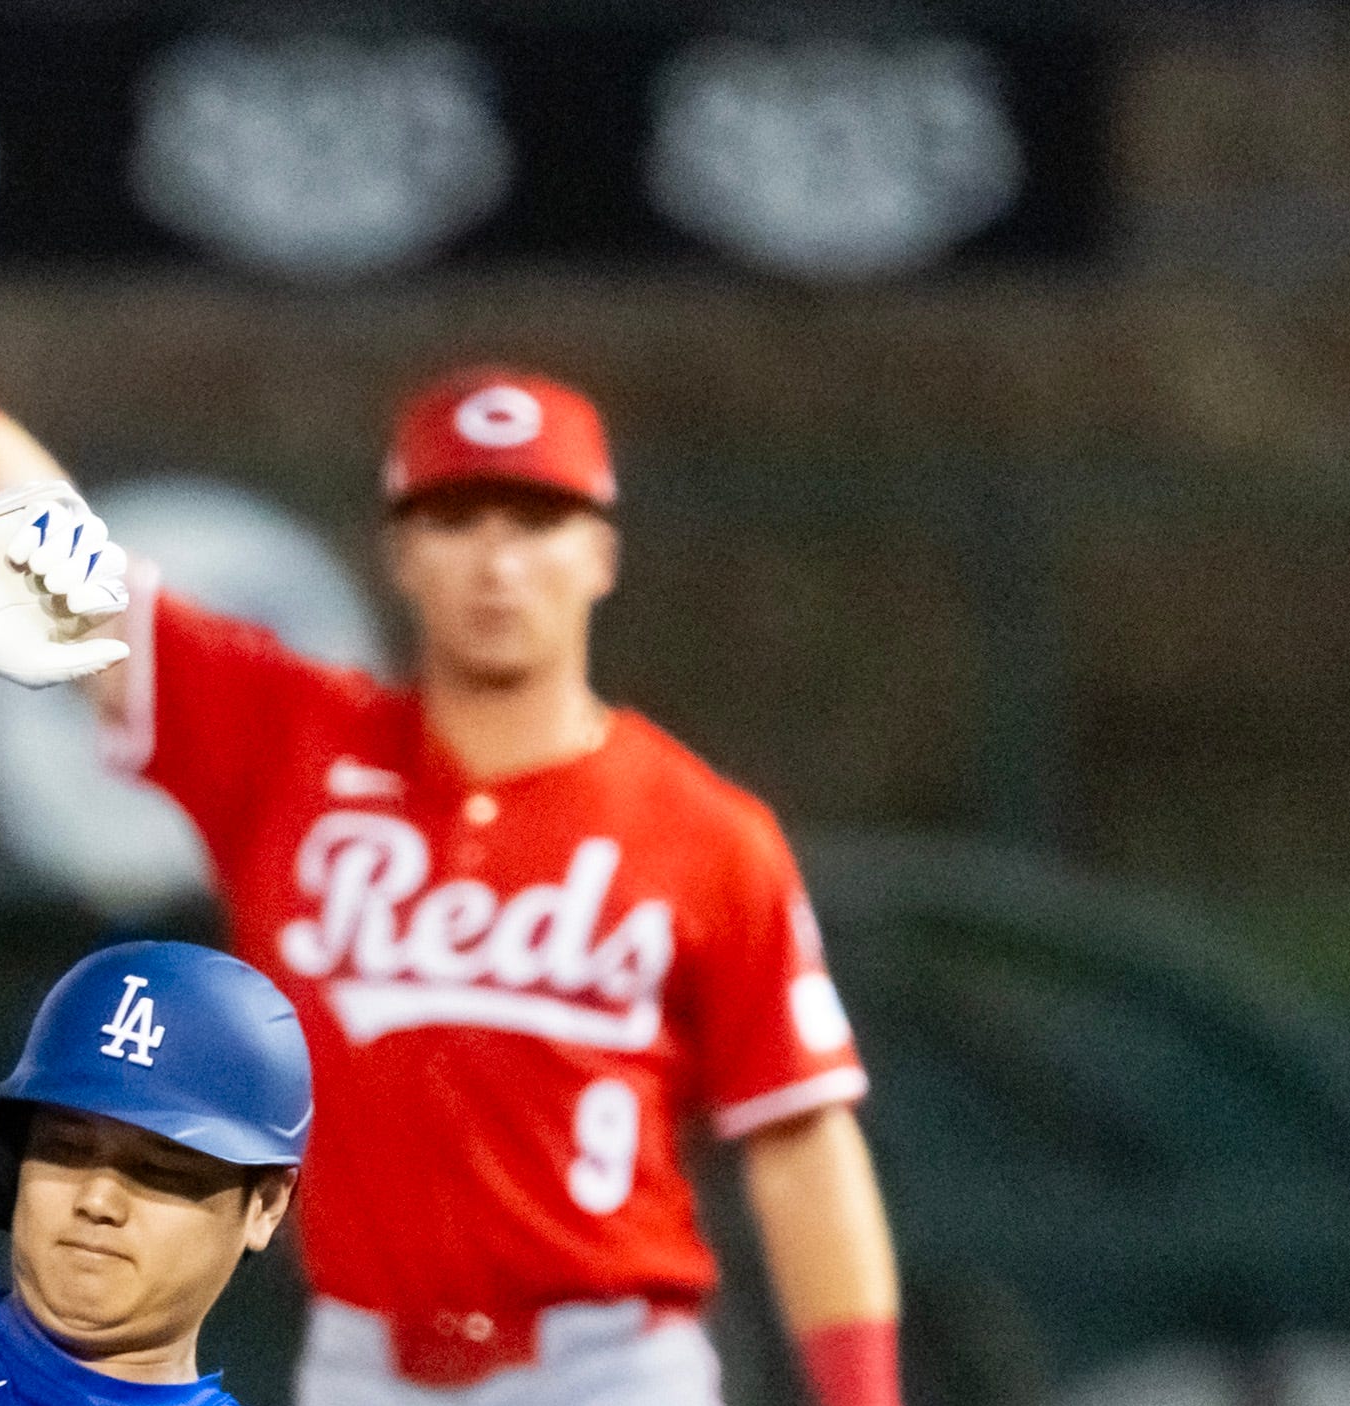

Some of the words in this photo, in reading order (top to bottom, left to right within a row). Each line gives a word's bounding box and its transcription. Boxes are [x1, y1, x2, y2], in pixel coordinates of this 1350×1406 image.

[279, 808, 674, 1010] Reds
[100, 974, 165, 1067] LA
[566, 1077, 641, 1217] 9
